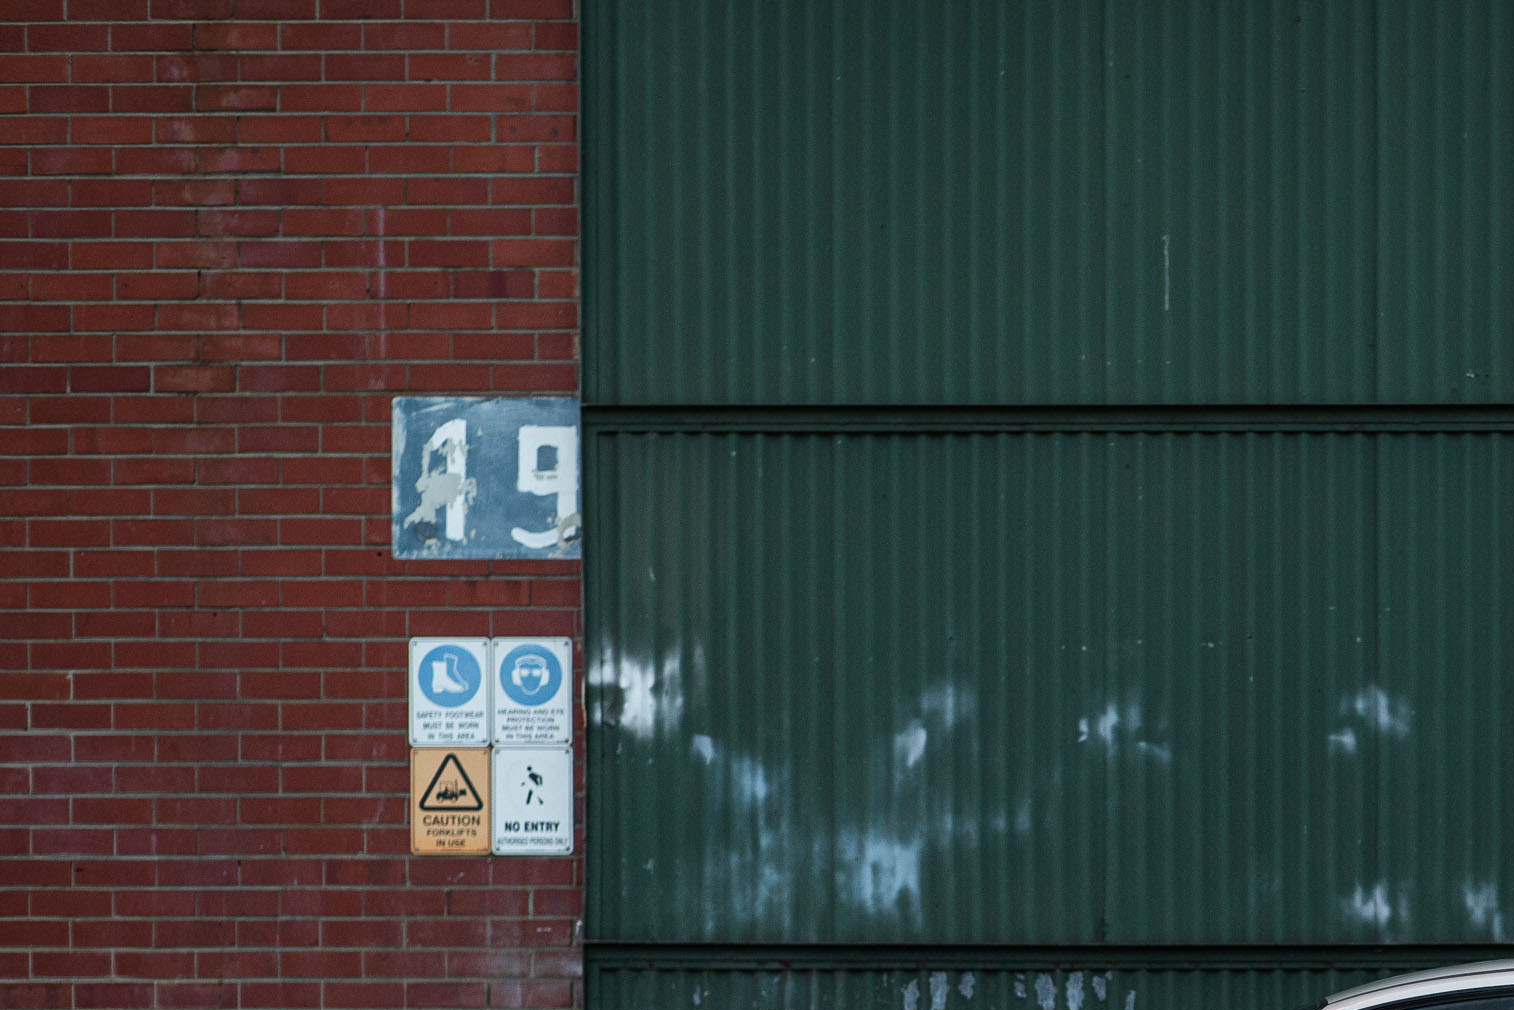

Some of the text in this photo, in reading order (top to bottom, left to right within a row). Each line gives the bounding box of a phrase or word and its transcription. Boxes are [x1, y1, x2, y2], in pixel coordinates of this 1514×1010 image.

[423, 815, 480, 826] CAUTION
[504, 821, 560, 832] NO ENTRY
[426, 829, 477, 837] FORKLIFTS
[436, 840, 465, 848] IN USE
